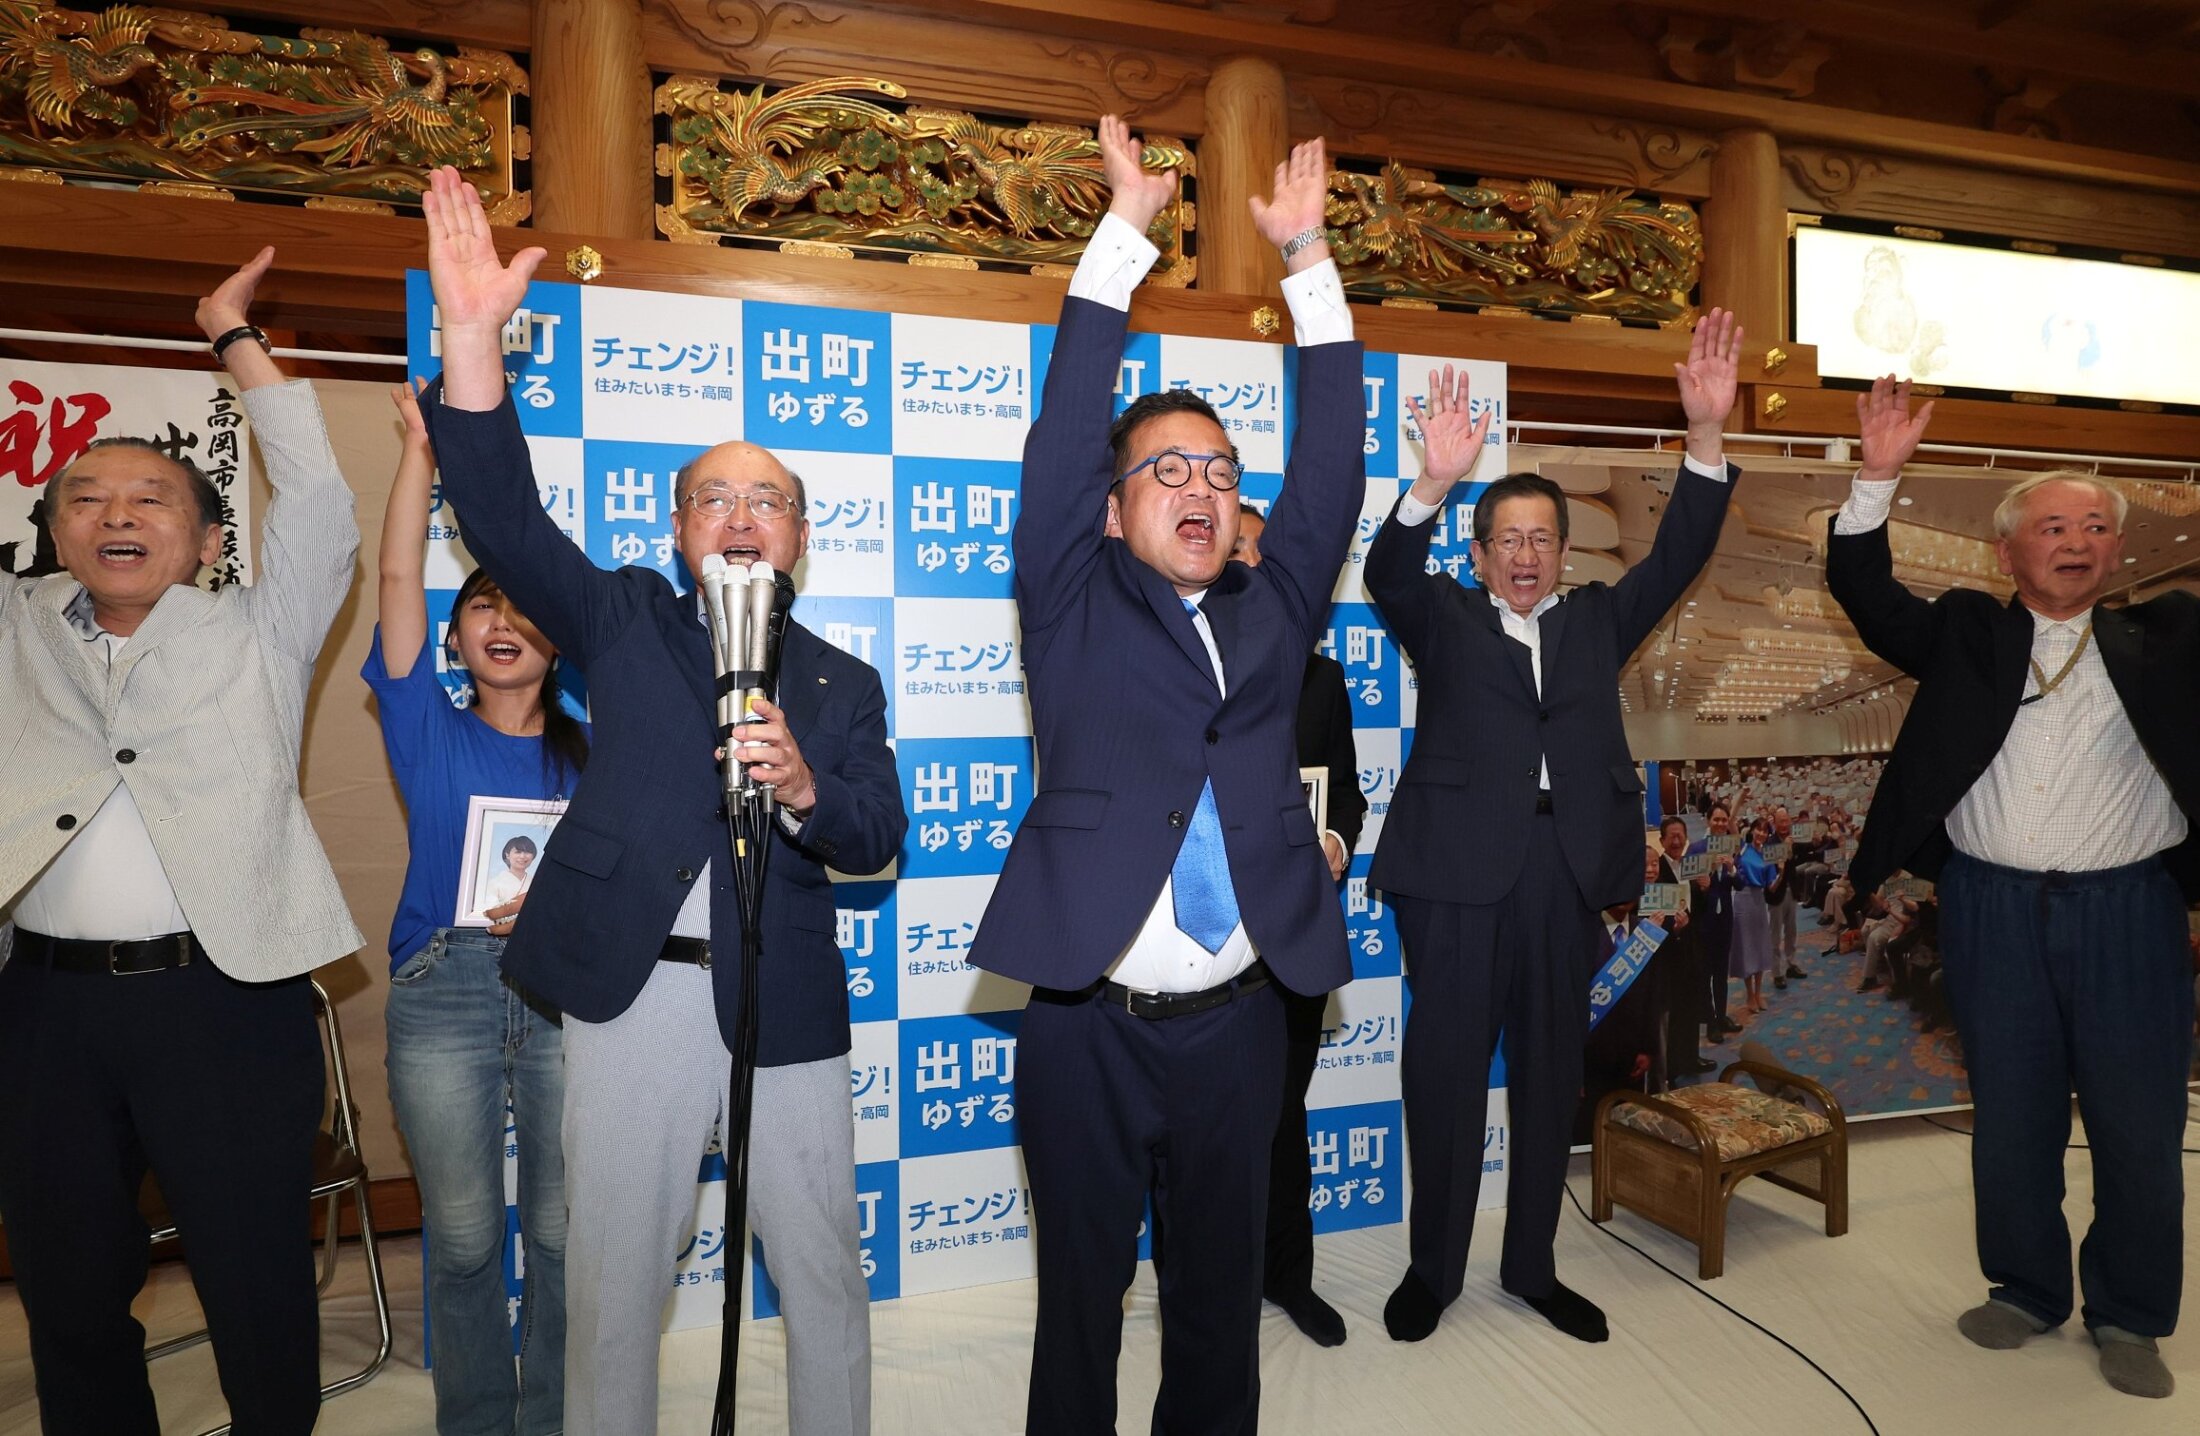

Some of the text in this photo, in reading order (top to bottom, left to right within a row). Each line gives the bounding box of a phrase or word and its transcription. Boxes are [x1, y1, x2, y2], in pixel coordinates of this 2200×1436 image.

[592, 337, 734, 376] チェンジ!
[761, 328, 874, 387] 出町
[594, 377, 733, 401] 住みたいまち・高岡
[900, 361, 1023, 395] チェンジ!
[768, 391, 869, 427] ゆずる
[902, 398, 1022, 420] 住みたいまち・高岡
[910, 482, 1016, 536] 出町
[916, 541, 1011, 575] ゆずる
[905, 681, 1024, 695] 住みたいまち・高岡
[913, 762, 1018, 814] 出町
[919, 819, 1013, 853] ゆずる
[916, 1037, 1018, 1093] 出町
[921, 1093, 1015, 1131] ゆずる
[1307, 1126, 1389, 1176] 出町
[908, 1188, 1029, 1232] チェンジ!
[1308, 1177, 1385, 1213] ゆずる
[910, 1225, 1029, 1255] 住みたいまち・高岡
